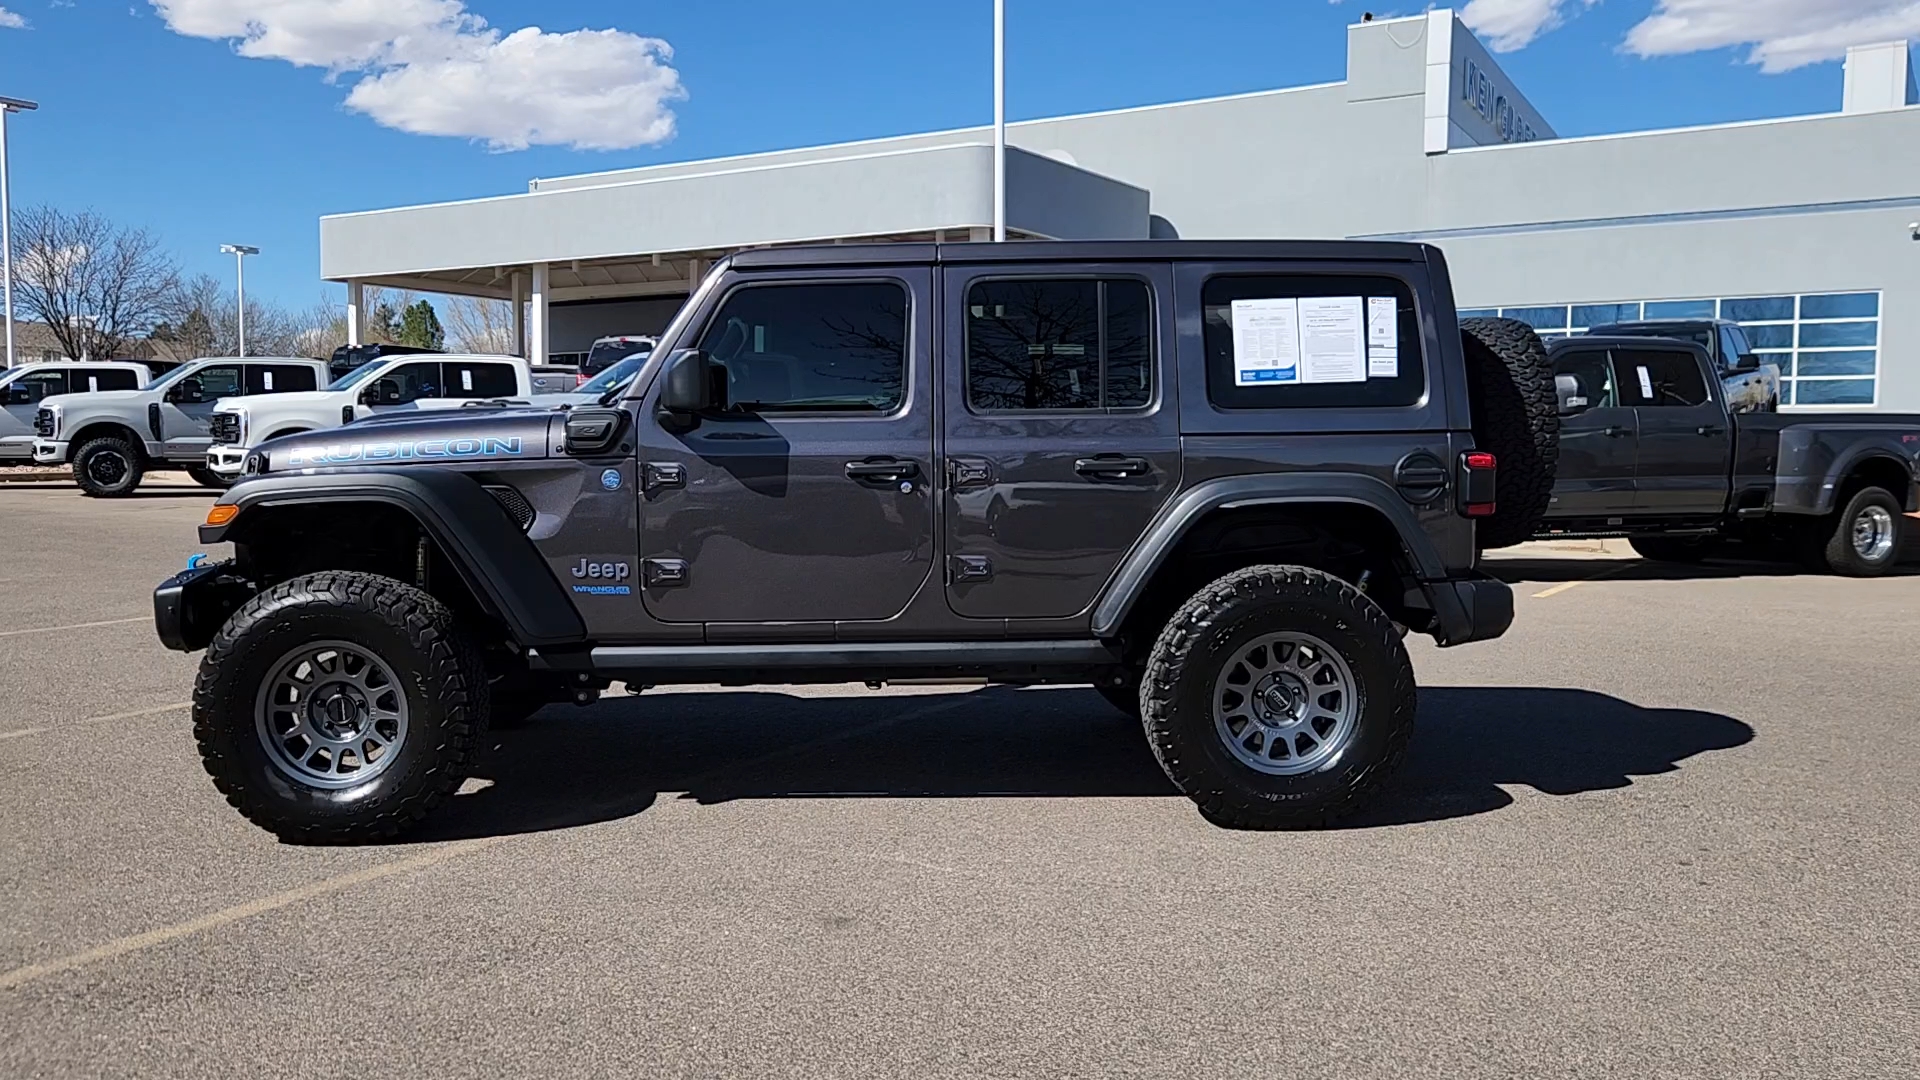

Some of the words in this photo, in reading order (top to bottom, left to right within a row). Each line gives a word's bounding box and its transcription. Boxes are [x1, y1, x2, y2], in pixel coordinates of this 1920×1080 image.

[1464, 57, 1495, 124] KEN
[288, 437, 522, 465] RUBICON
[571, 558, 629, 581] Jeep
[572, 585, 630, 593] WRANGLER
